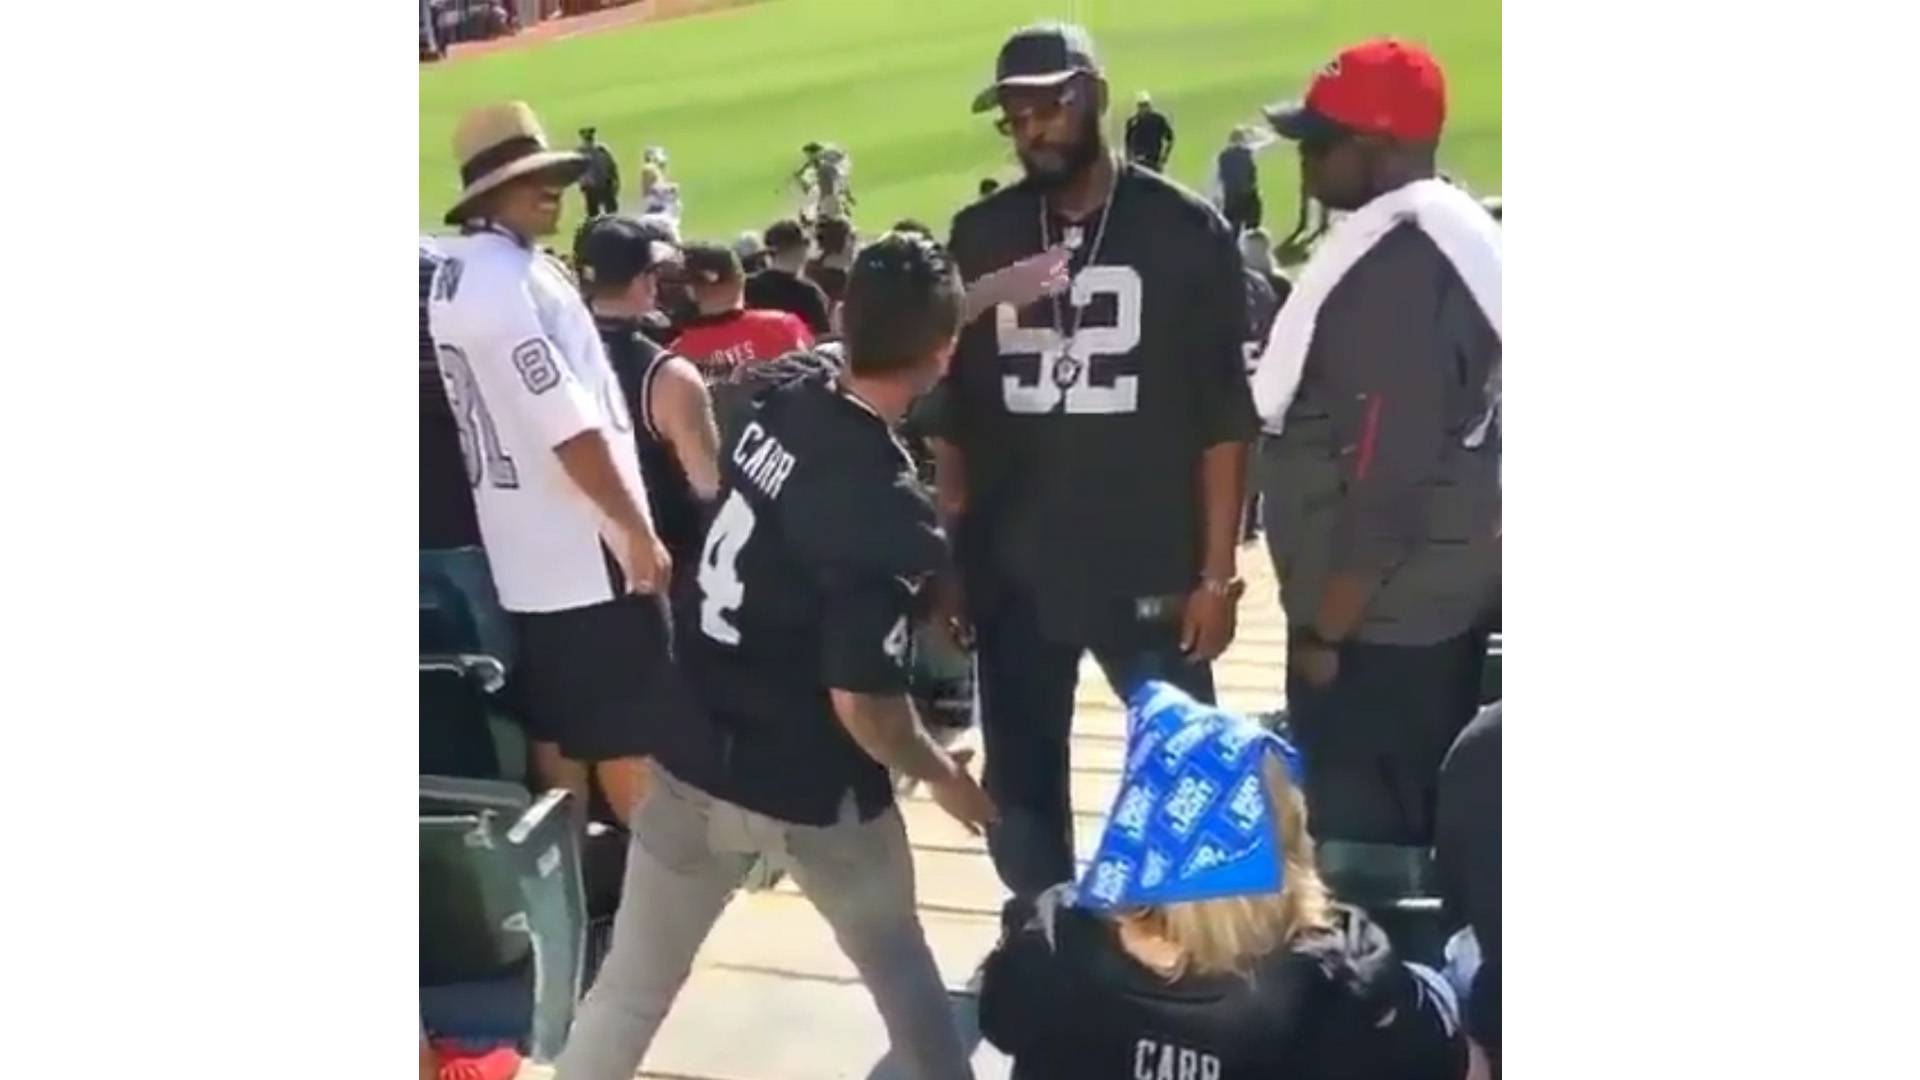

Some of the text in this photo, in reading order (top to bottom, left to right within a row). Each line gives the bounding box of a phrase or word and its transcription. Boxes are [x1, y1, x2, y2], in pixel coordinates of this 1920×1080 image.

[996, 265, 1142, 414] 52
[733, 422, 796, 499] CARR
[697, 488, 755, 645] 4
[883, 615, 909, 667] 4
[1134, 1038, 1221, 1080] CARR
